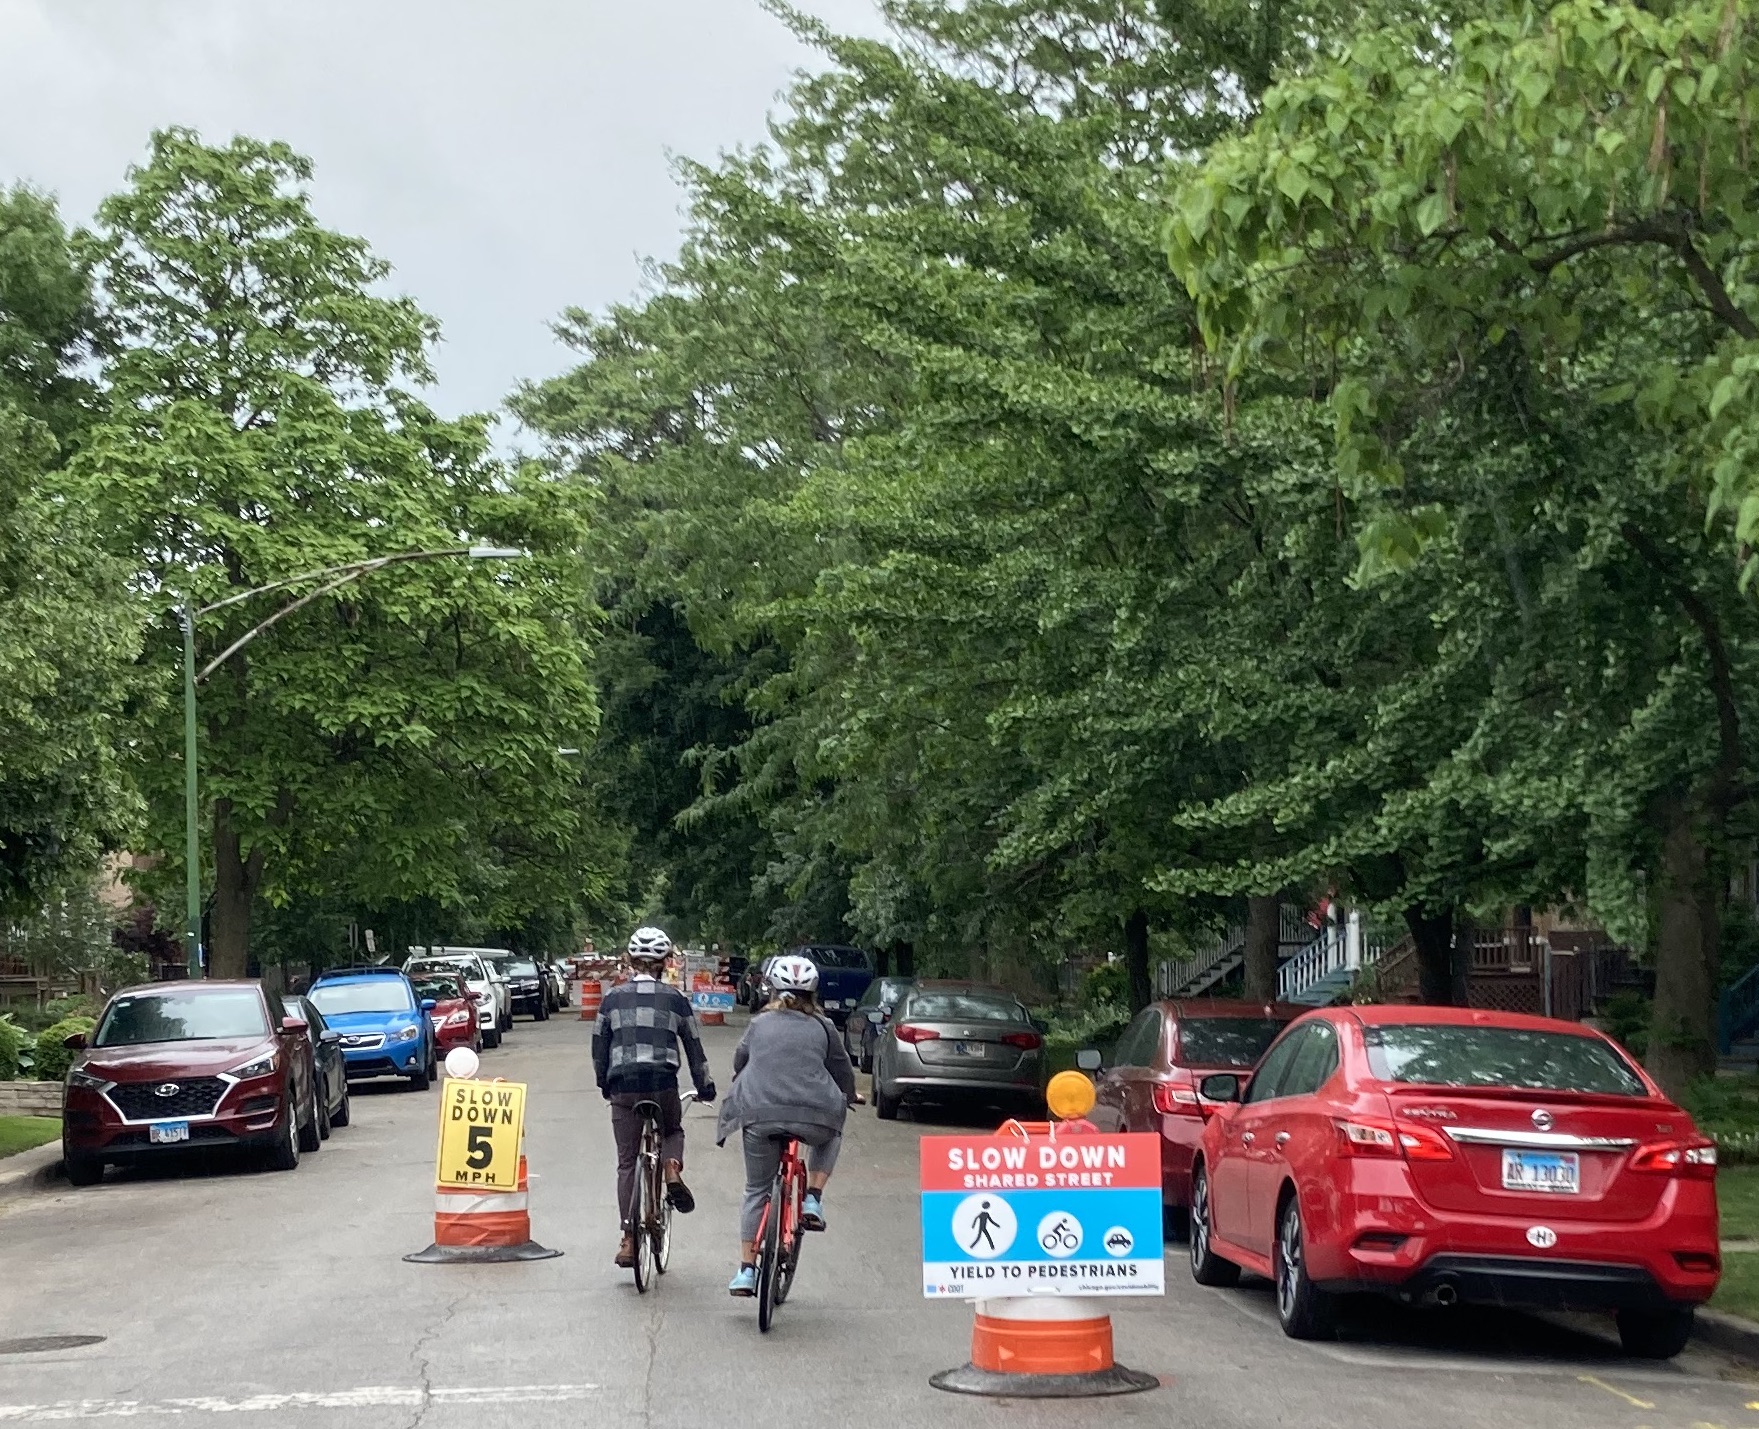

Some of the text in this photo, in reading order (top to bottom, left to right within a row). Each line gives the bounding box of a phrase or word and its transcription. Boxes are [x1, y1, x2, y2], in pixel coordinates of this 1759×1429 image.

[456, 1088, 512, 1107] SLOW
[452, 1105, 513, 1125] DOWN
[465, 1125, 493, 1170] 5
[948, 1145, 1126, 1171] SLOW DOWN
[455, 1170, 496, 1183] MPH
[963, 1171, 1114, 1189] SHARED STREET
[949, 1264, 1138, 1280] YIELD TO PEDESTRIANS
